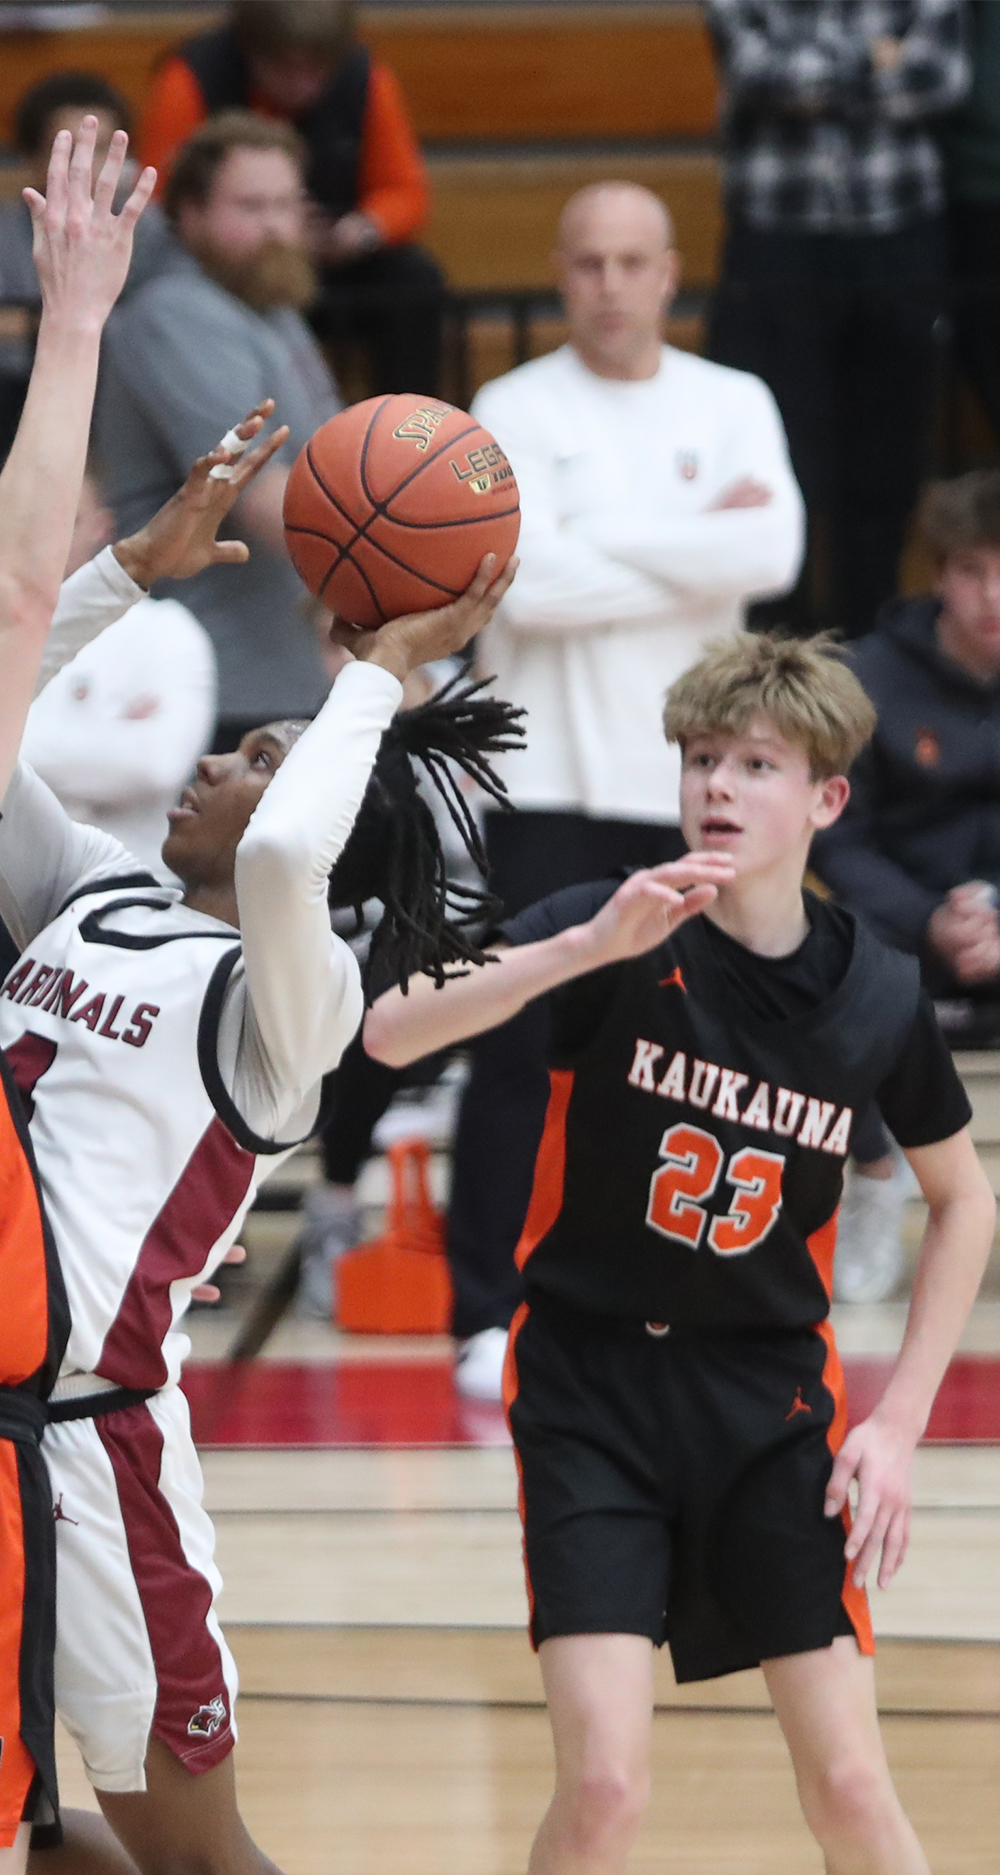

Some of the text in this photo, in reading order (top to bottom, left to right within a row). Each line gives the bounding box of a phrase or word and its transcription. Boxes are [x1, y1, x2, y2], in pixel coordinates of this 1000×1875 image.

[0, 957, 160, 1048] ARDINALS
[627, 1037, 852, 1155] KAUKAUNA
[645, 1122, 786, 1257] 23
